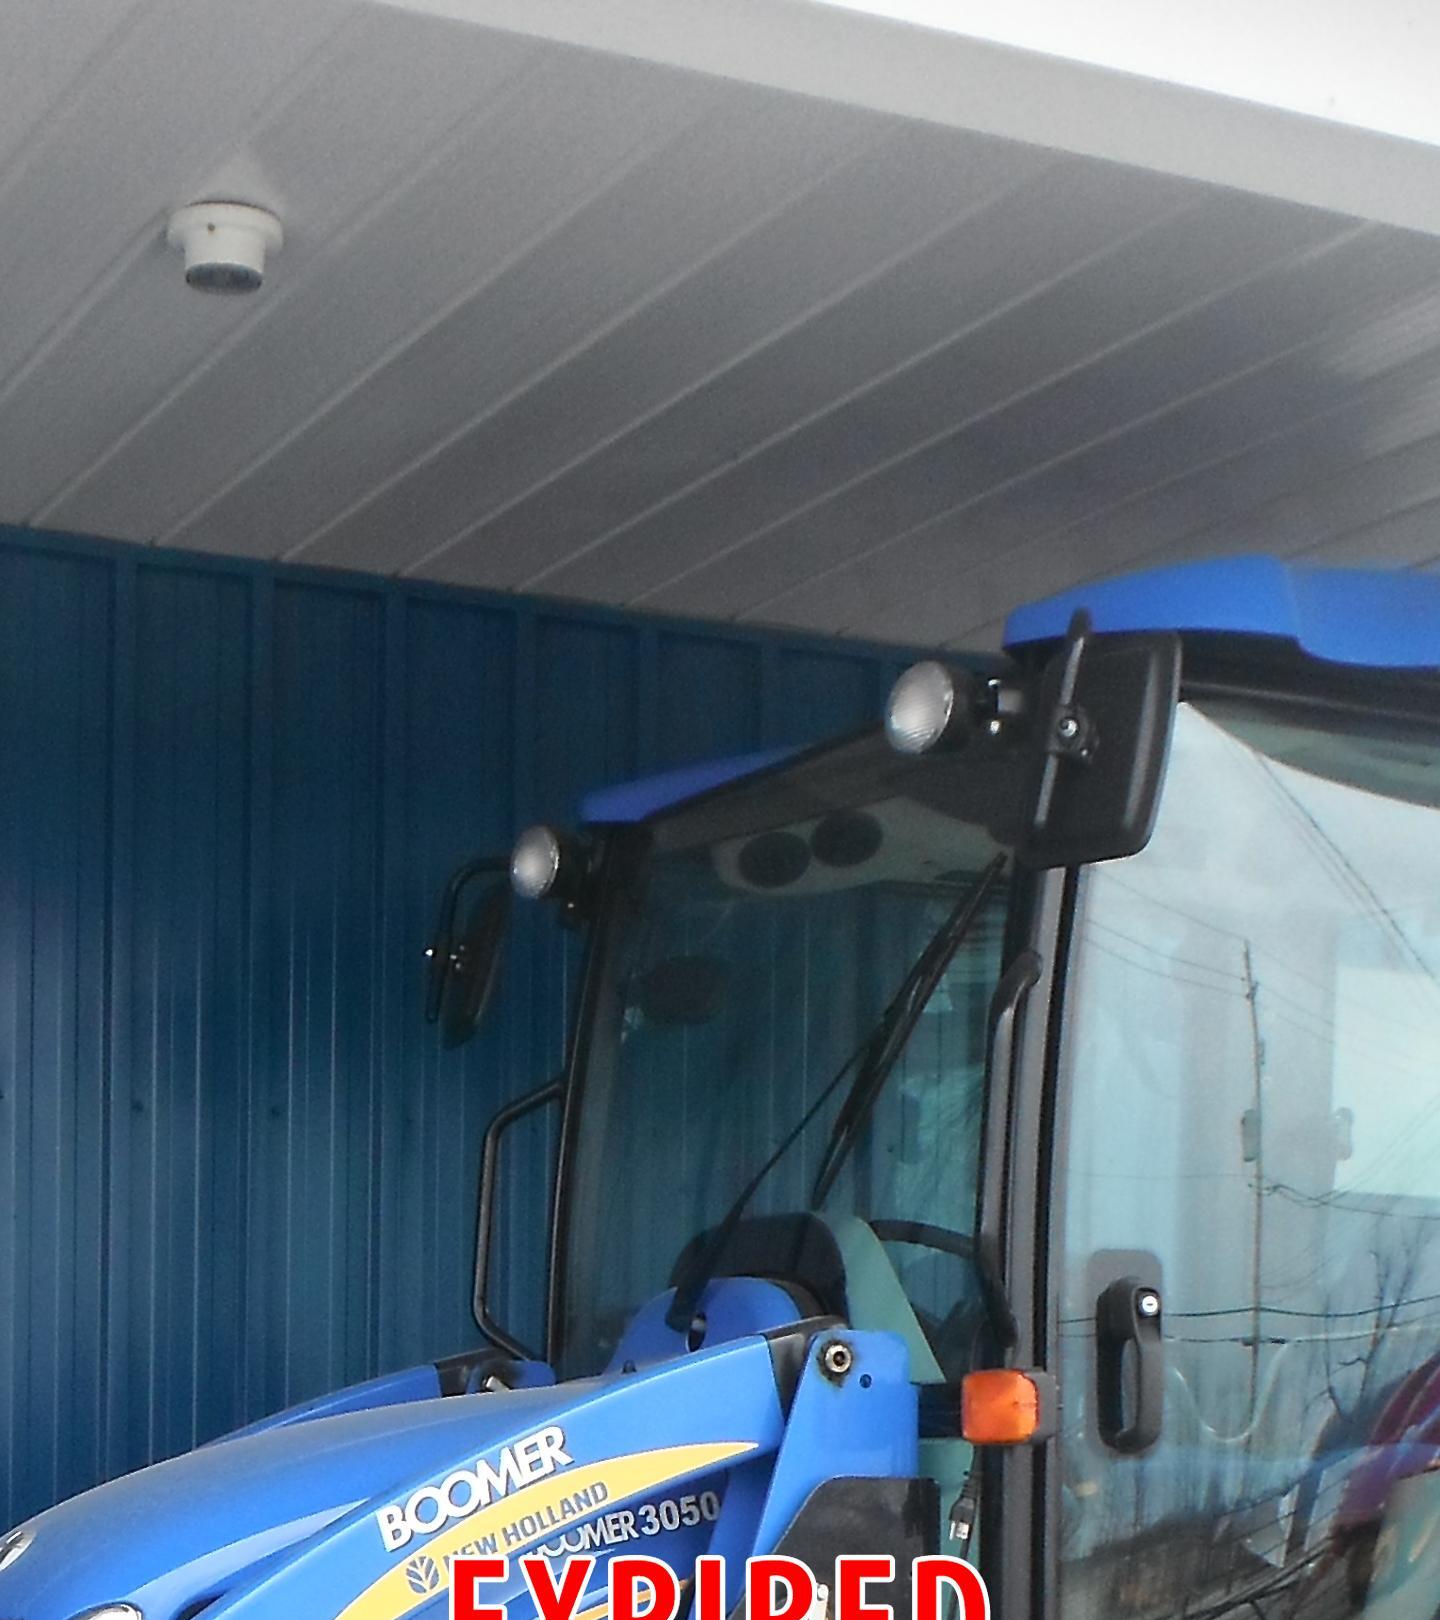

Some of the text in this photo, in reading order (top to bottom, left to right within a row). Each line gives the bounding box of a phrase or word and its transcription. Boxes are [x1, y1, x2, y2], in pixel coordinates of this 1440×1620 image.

[374, 1426, 575, 1552] BOOMER
[502, 1481, 609, 1547] HOLLAND
[528, 1490, 722, 1557] OOMER 3050
